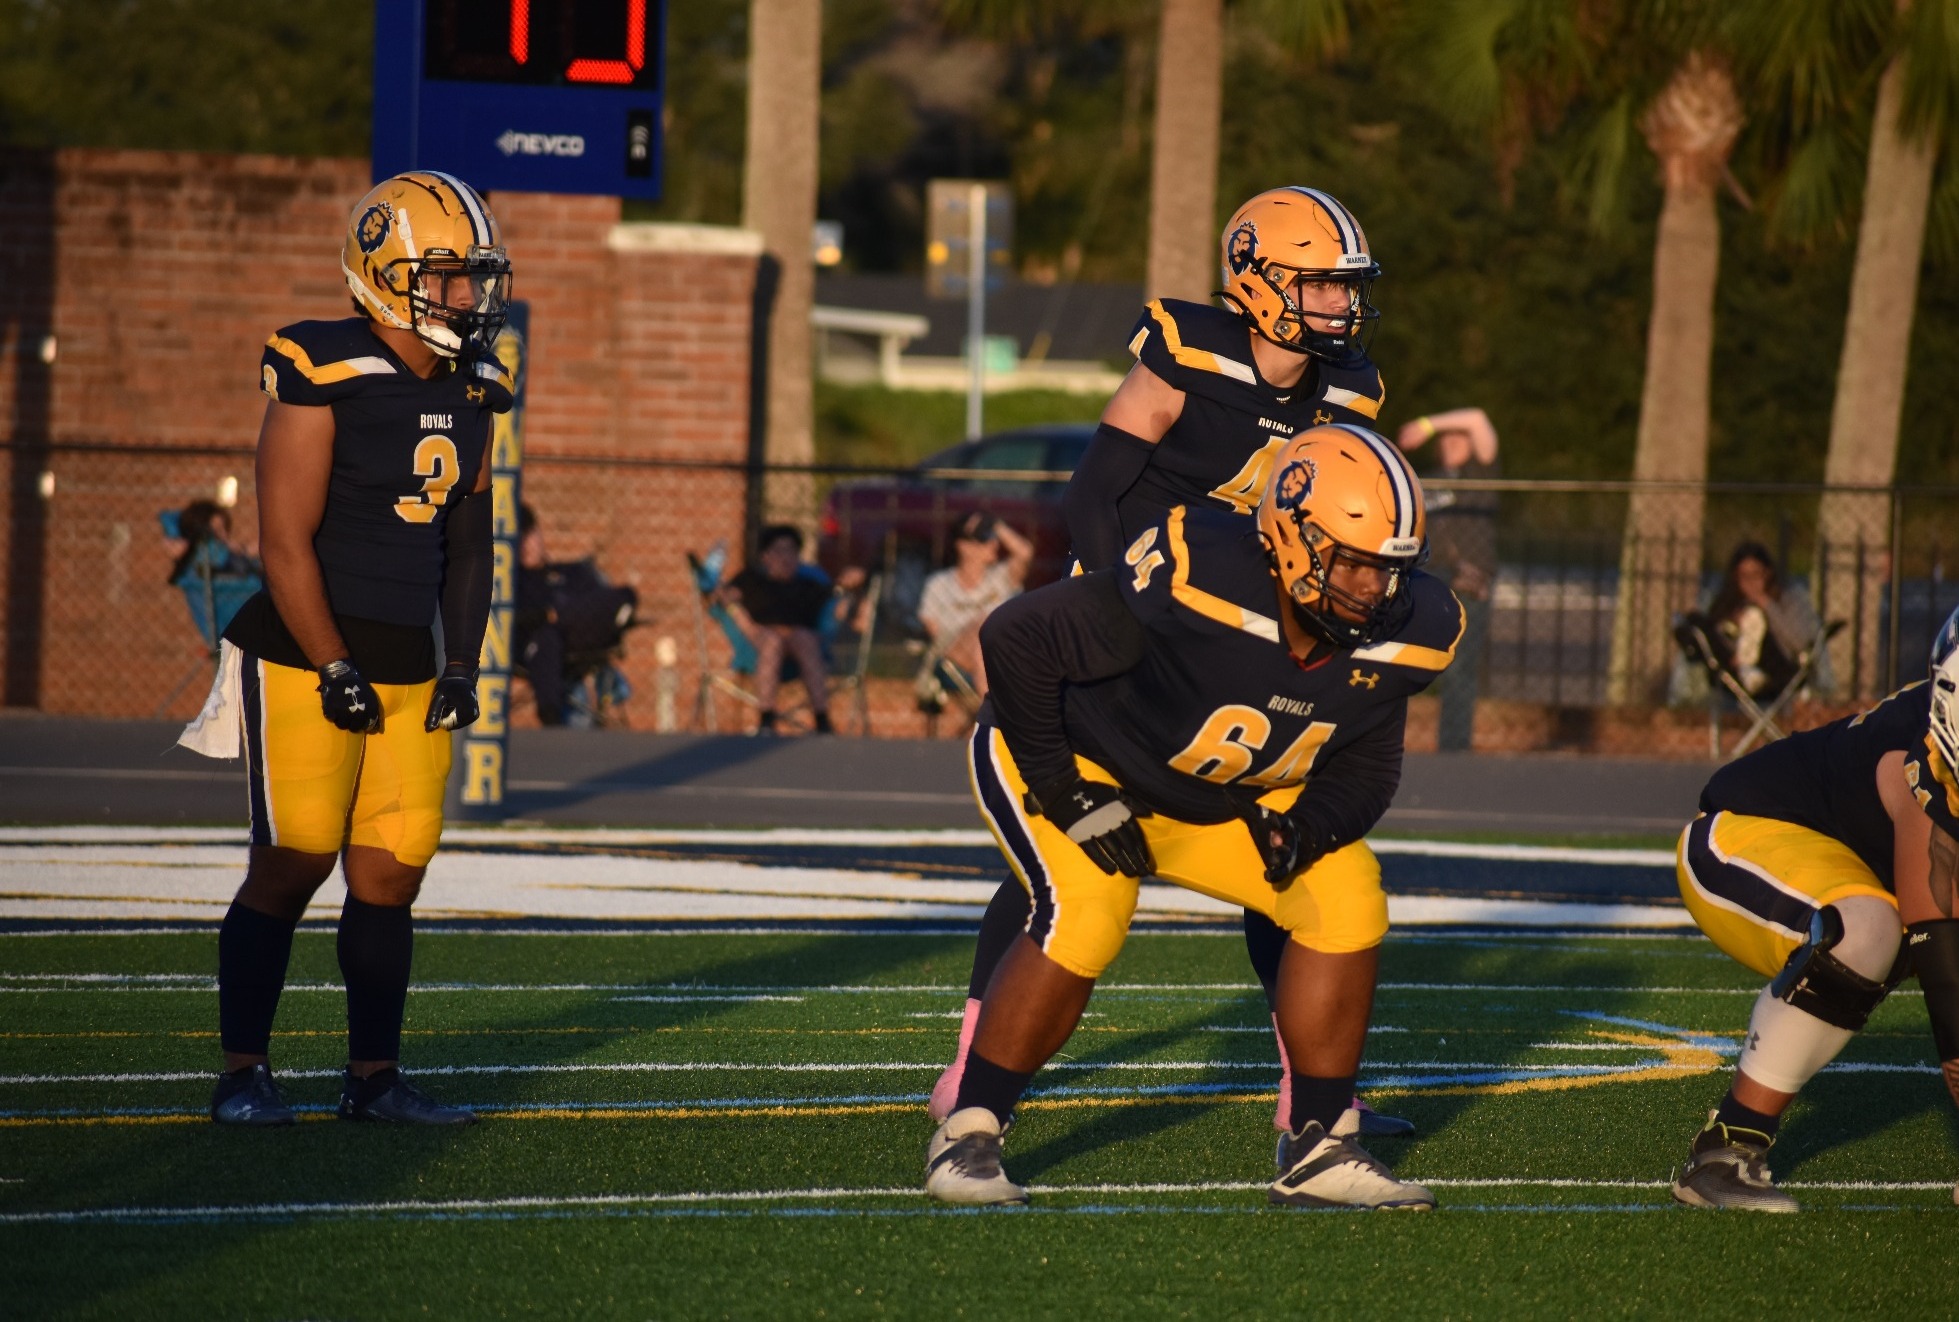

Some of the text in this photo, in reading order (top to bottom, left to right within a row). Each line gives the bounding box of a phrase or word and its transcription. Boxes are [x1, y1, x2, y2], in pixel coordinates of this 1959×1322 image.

[420, 414, 453, 429] ROYALS
[393, 434, 460, 523] 3
[1207, 435, 1290, 515] 4
[1125, 526, 1165, 592] 64
[1267, 694, 1315, 716] ROYALS
[1168, 704, 1337, 789] 64
